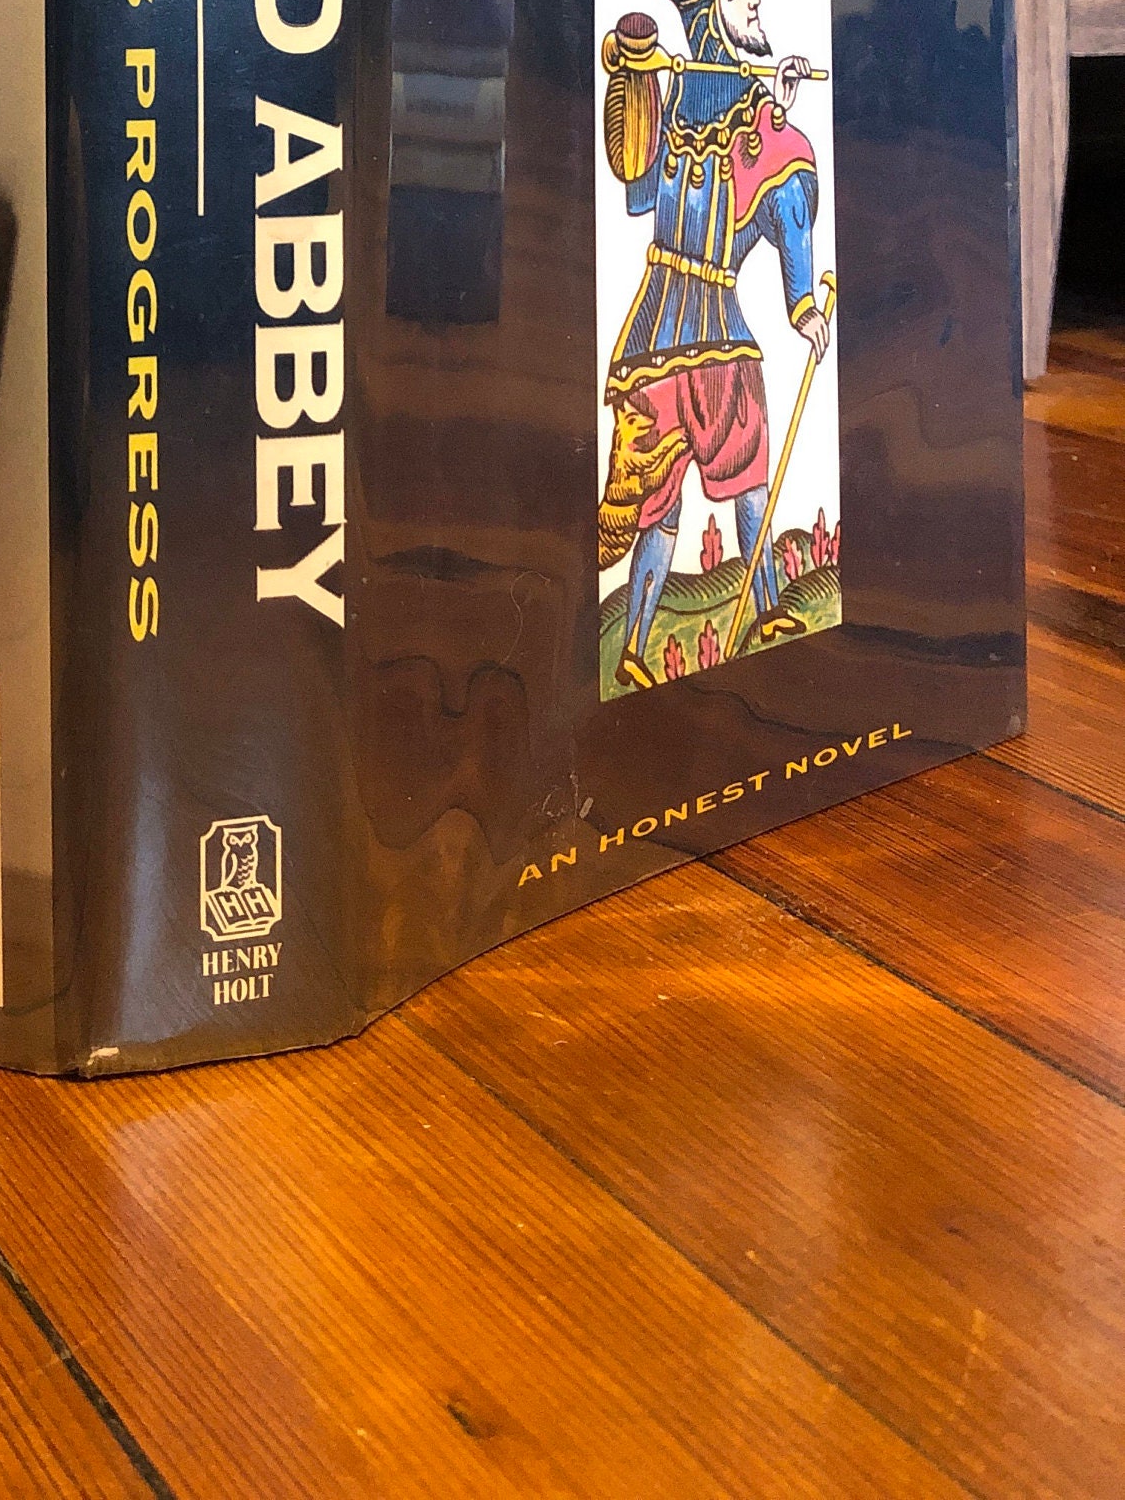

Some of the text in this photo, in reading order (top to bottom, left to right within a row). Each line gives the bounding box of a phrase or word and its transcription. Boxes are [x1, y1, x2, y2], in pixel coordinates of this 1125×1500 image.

[124, 47, 159, 643] PROGRESS
[252, 94, 348, 629] ABBEY
[517, 722, 913, 887] AN HONEST NOVEL
[202, 942, 283, 977] HENRY
[213, 973, 274, 1005] HOLT
